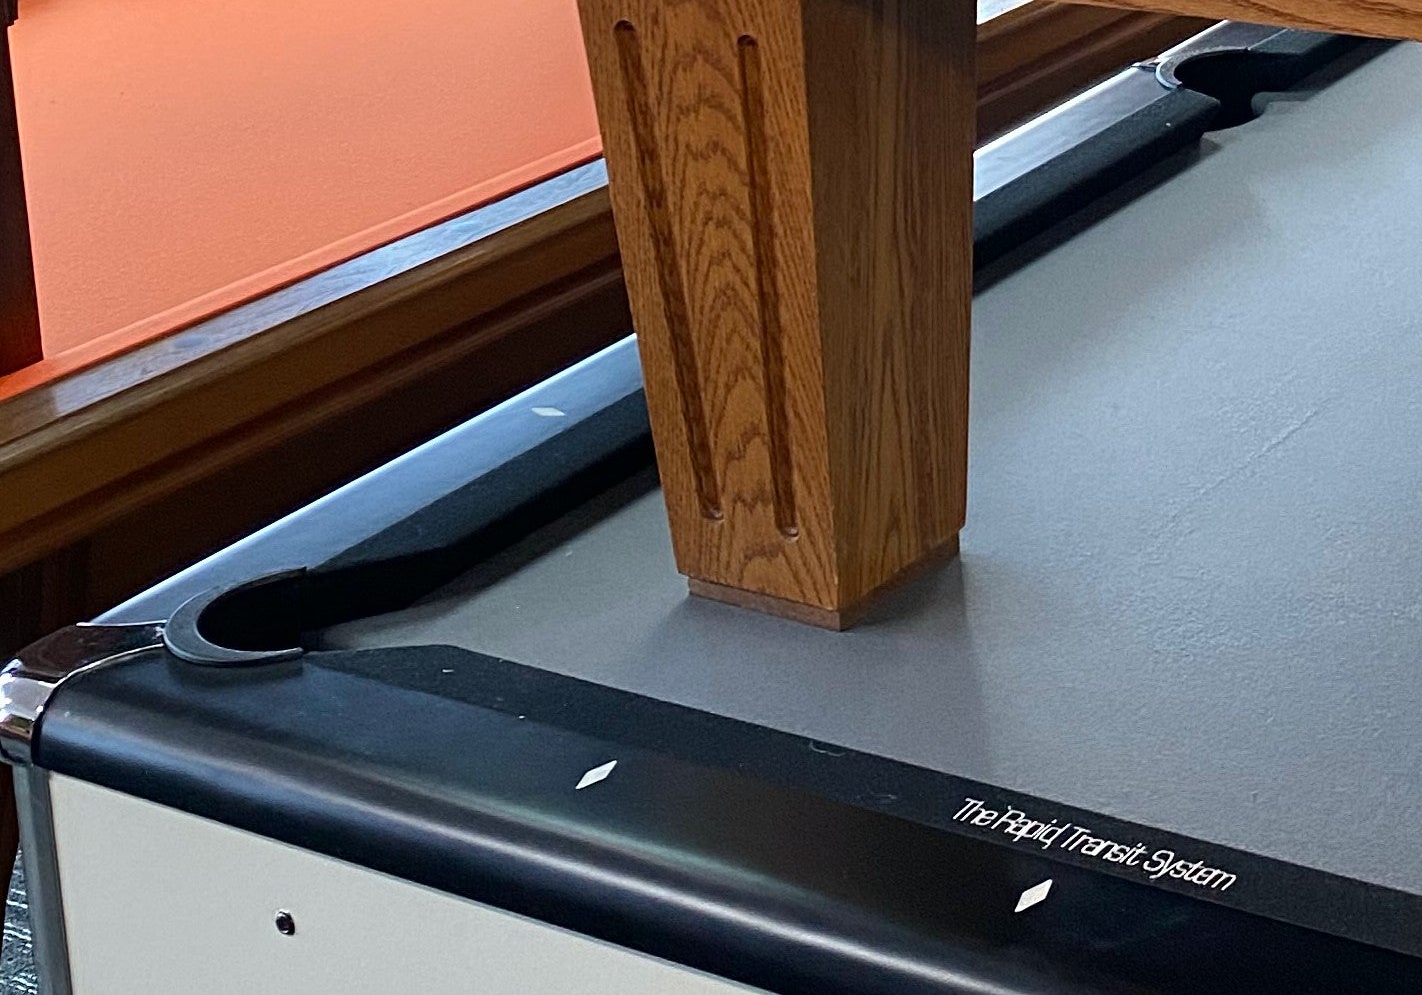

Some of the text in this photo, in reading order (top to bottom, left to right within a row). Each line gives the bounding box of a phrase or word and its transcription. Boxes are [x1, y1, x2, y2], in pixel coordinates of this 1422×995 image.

[951, 797, 1237, 892] The Rapid Transit System
